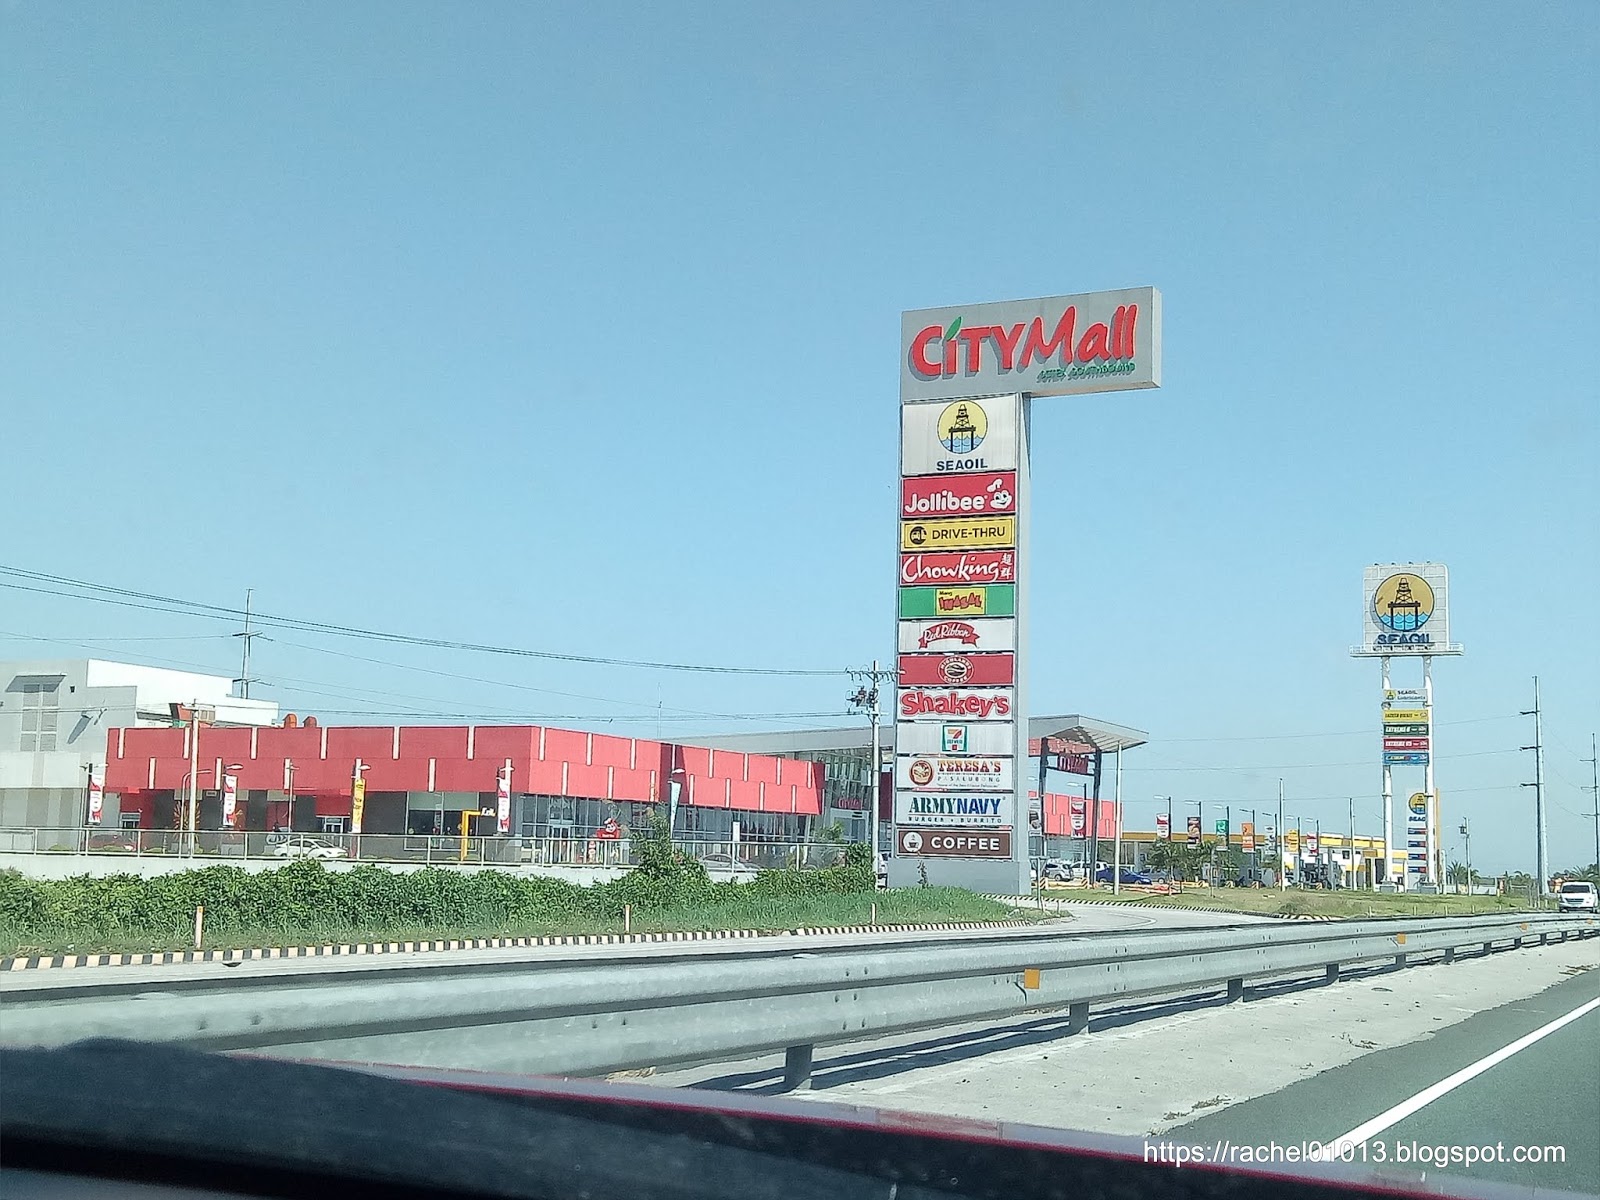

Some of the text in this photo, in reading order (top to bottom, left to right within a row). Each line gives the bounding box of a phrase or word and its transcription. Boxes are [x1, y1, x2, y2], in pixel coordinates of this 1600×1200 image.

[936, 458, 988, 471] SEAOIL
[904, 489, 985, 513] Jollibee
[932, 527, 1005, 540] DRIVE-THRU
[902, 554, 999, 583] Chowking
[924, 623, 971, 643] Red Ribbon
[901, 691, 1009, 718] Shakey's
[937, 760, 1001, 773] TERESA'S
[931, 837, 1000, 851] COFFEE
